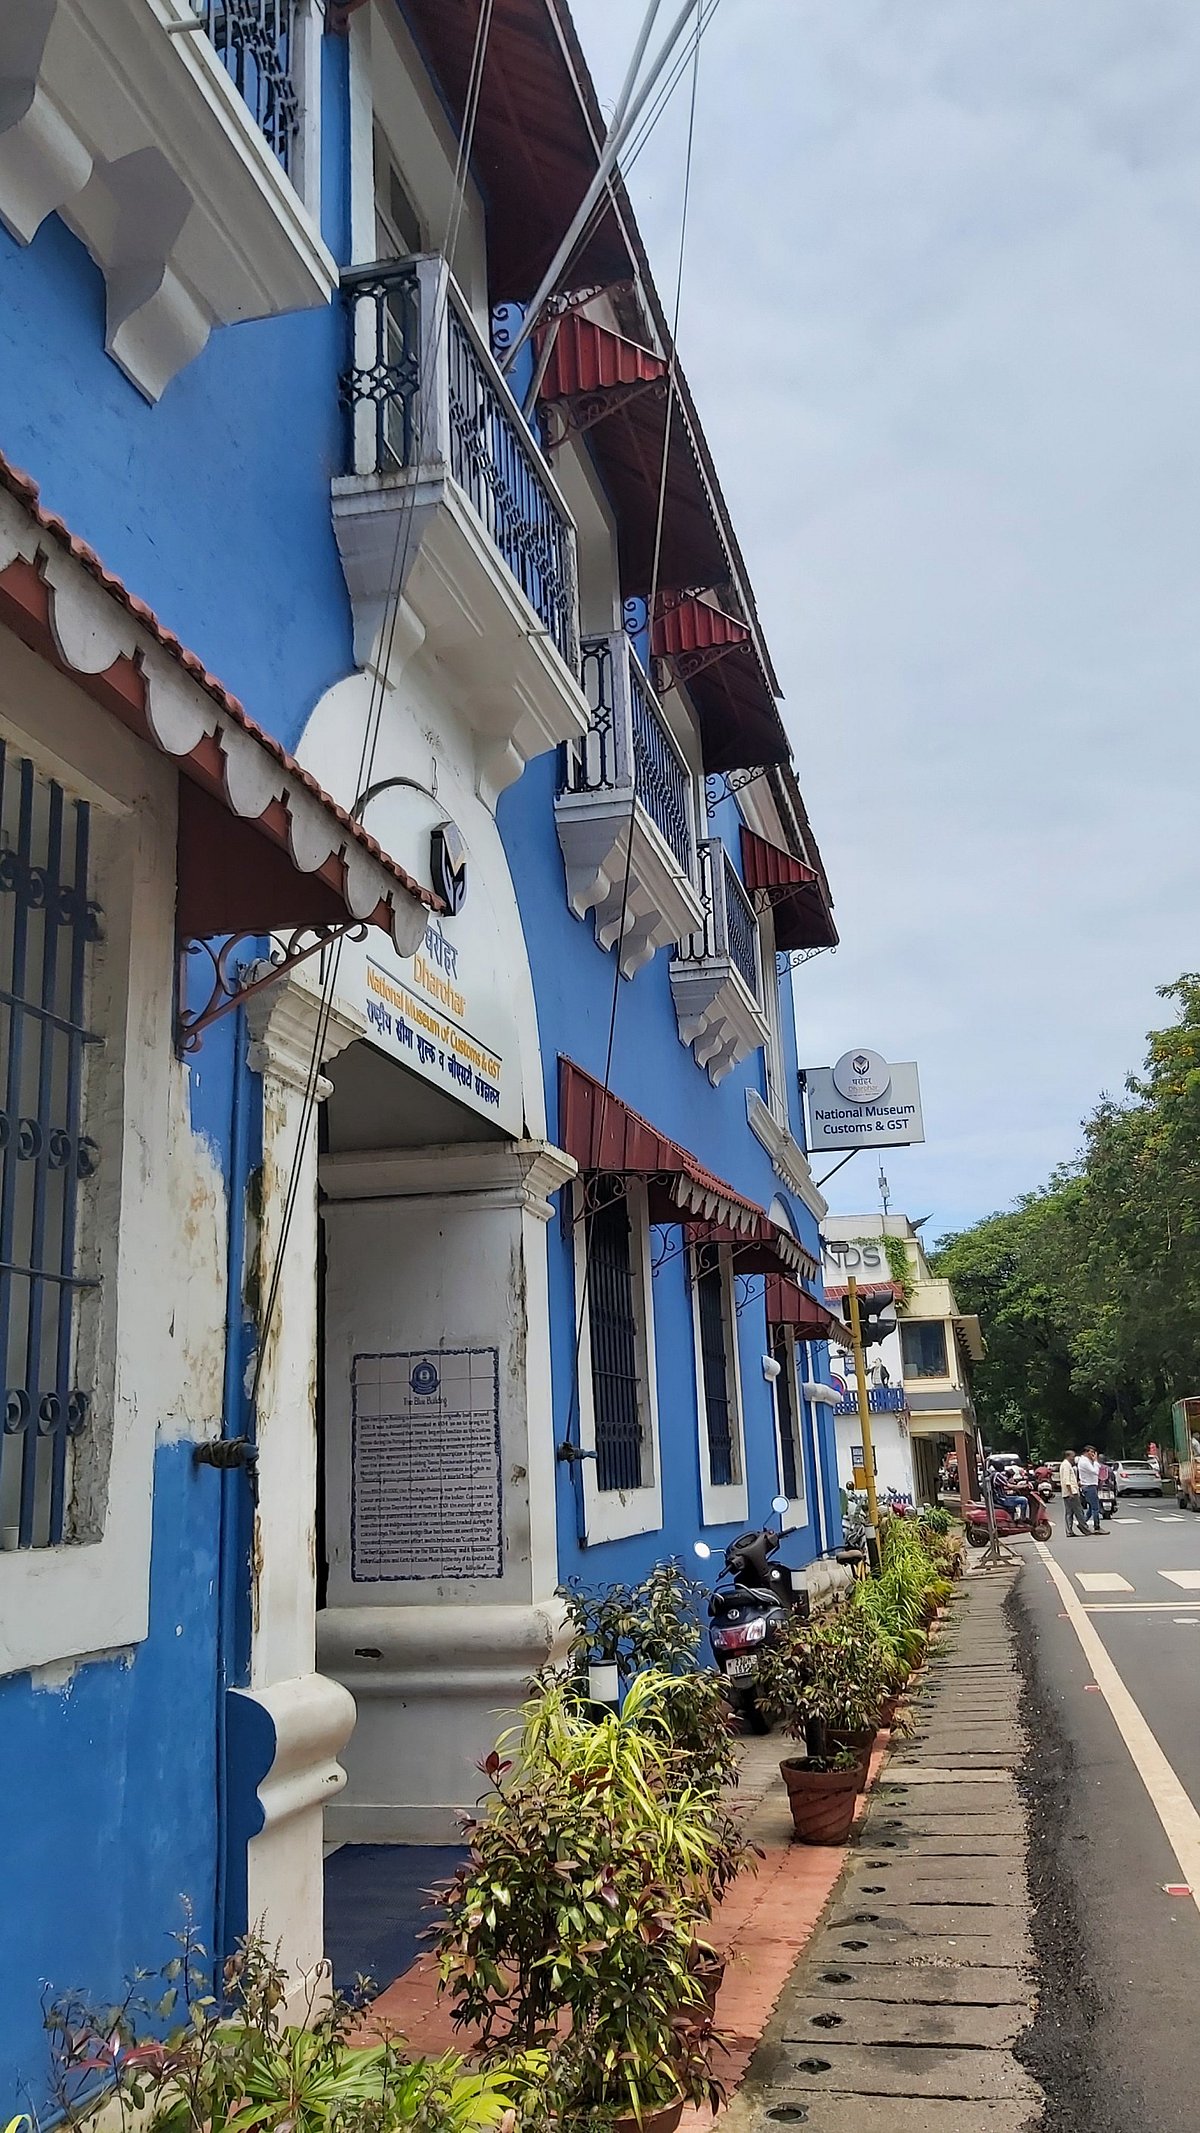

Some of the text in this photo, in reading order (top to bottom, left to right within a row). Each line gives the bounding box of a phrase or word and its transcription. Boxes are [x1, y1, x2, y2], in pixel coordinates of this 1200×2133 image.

[425, 919, 458, 980] धरोहर
[413, 952, 464, 1017] Dharohar
[366, 998, 392, 1035] राष्ट्रीय
[395, 1016, 413, 1050] सीमा
[416, 1033, 436, 1064] शुल्क
[438, 1049, 445, 1071] व
[367, 965, 500, 1081] National Museum of Customs & GST
[815, 1105, 915, 1120] National Museum
[823, 1119, 909, 1134] Customs & GST
